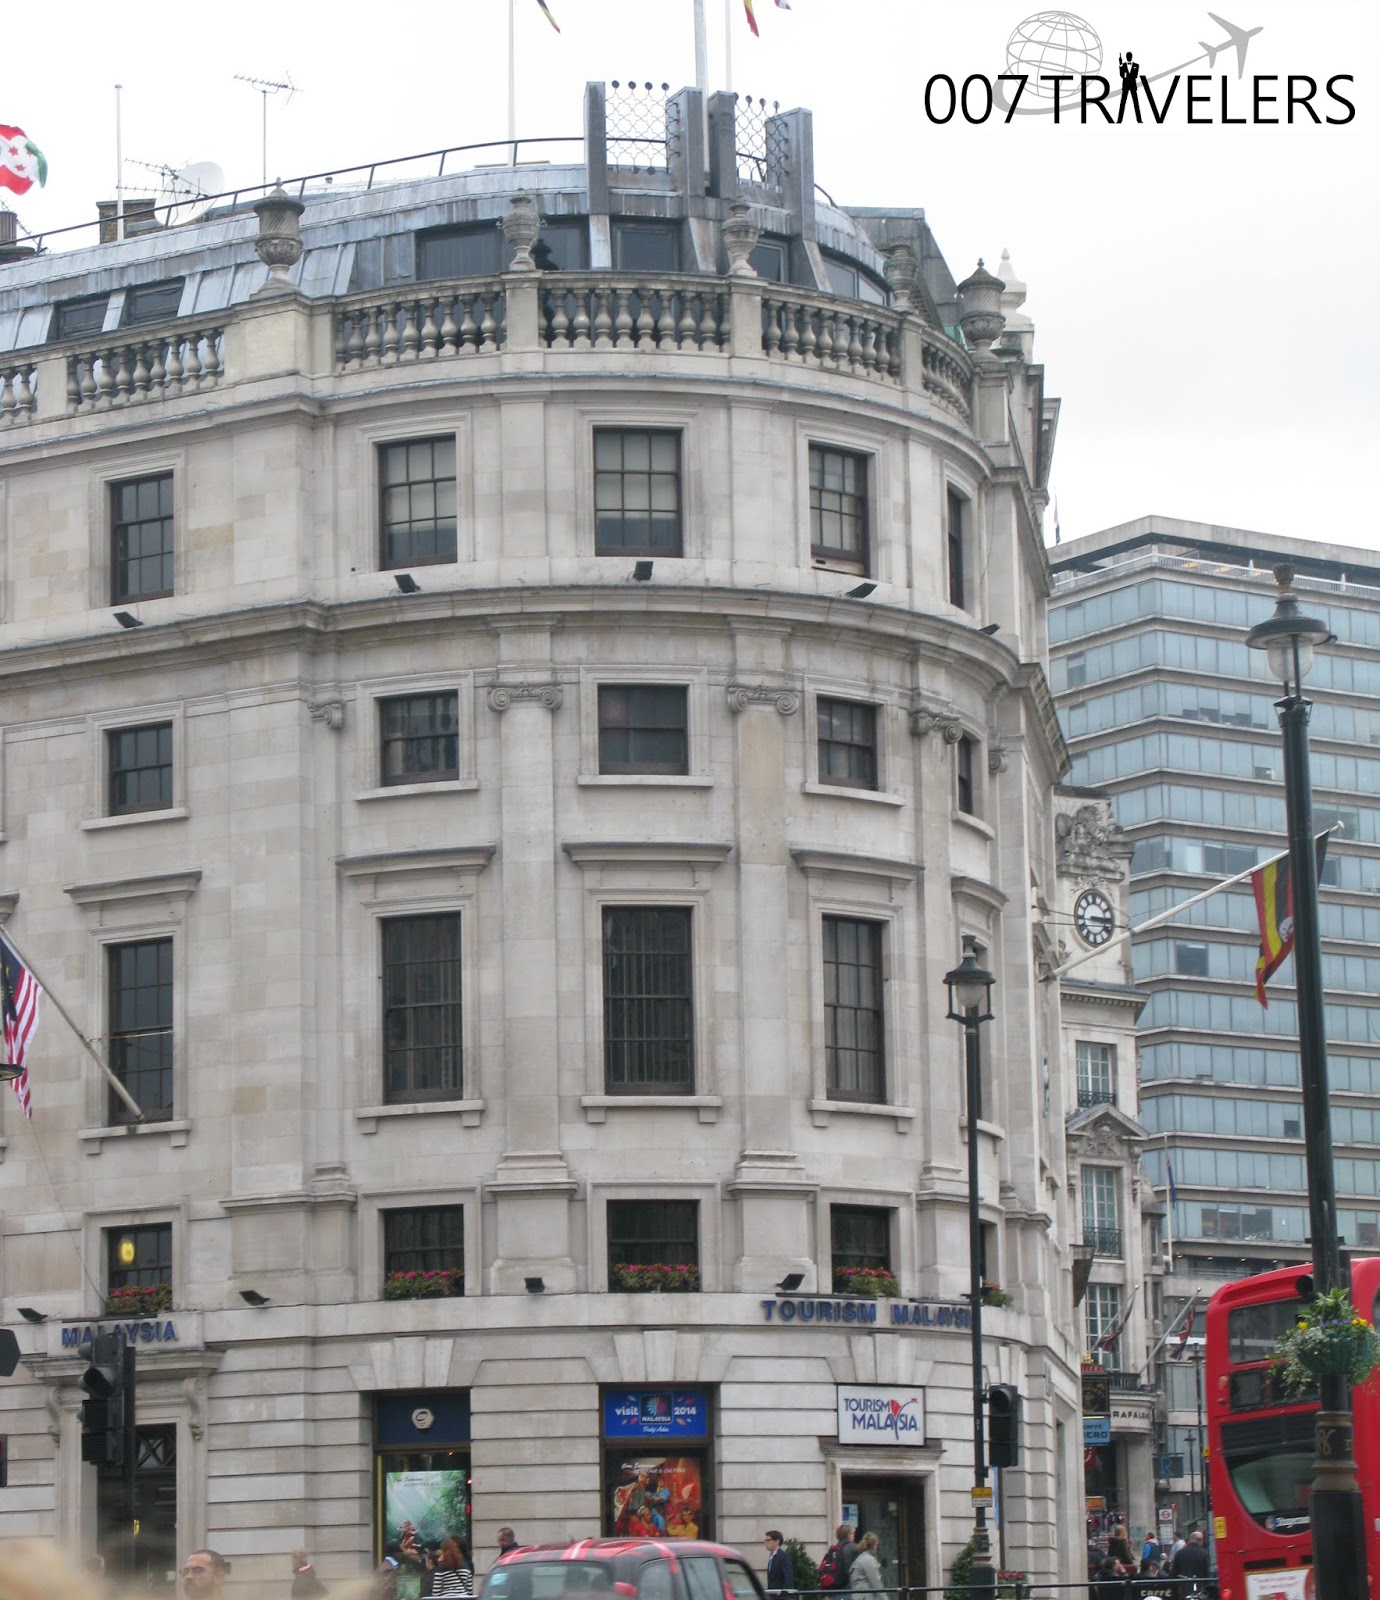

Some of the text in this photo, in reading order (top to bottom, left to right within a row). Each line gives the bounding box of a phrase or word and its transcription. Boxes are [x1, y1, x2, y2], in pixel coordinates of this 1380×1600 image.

[762, 1300, 973, 1329] TOURISM MALAYSI
[615, 1406, 697, 1416] visit 2014
[843, 1398, 890, 1412] TOURISM
[852, 1412, 918, 1440] MALAYSIA
